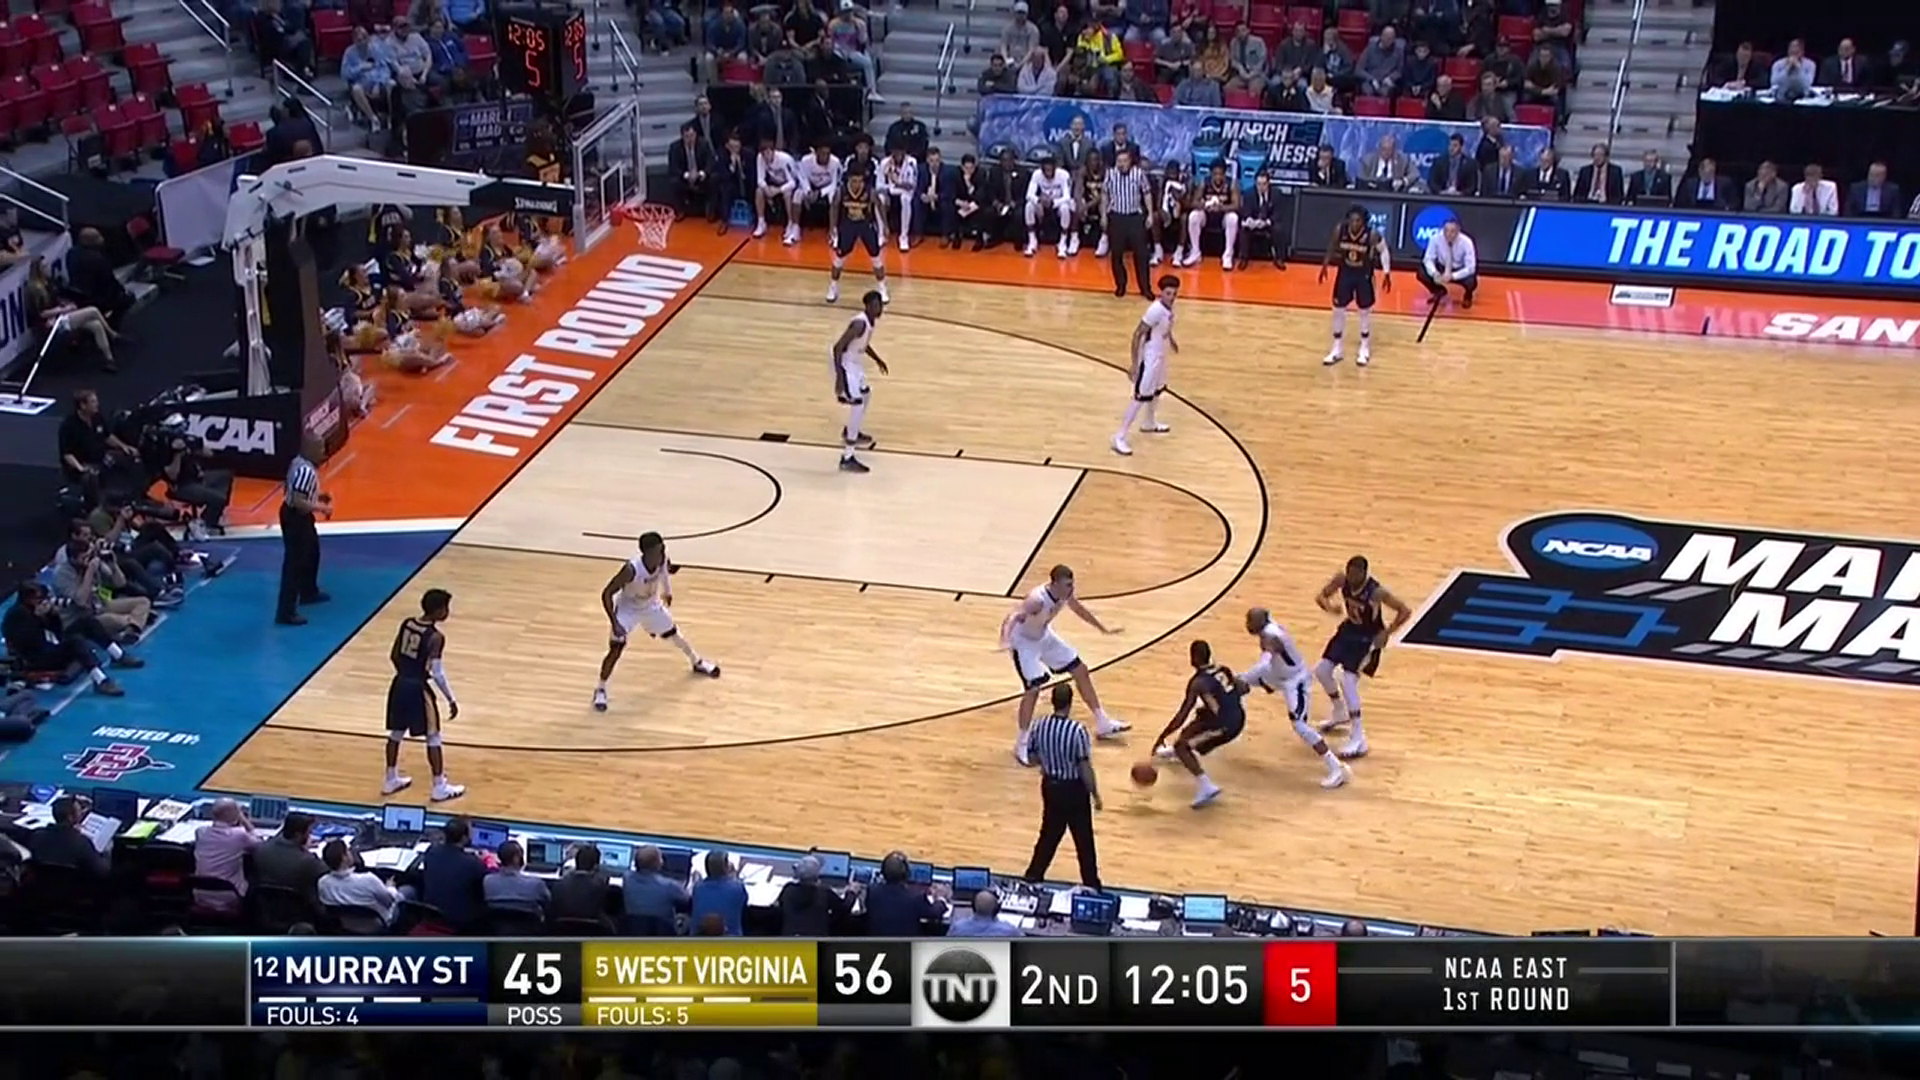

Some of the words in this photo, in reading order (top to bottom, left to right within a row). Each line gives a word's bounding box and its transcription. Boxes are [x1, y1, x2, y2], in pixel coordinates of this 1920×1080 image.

[508, 24, 545, 51] 12:05
[525, 50, 541, 87] 5
[1608, 217, 1701, 267] THE
[1707, 223, 1849, 275] ROAD
[1863, 231, 1920, 279] TO
[1764, 311, 1920, 343] SAN
[429, 353, 596, 457] FIRST
[534, 253, 704, 358] ROUND
[1542, 539, 1654, 562] NCAA
[92, 725, 170, 743] HOSTED
